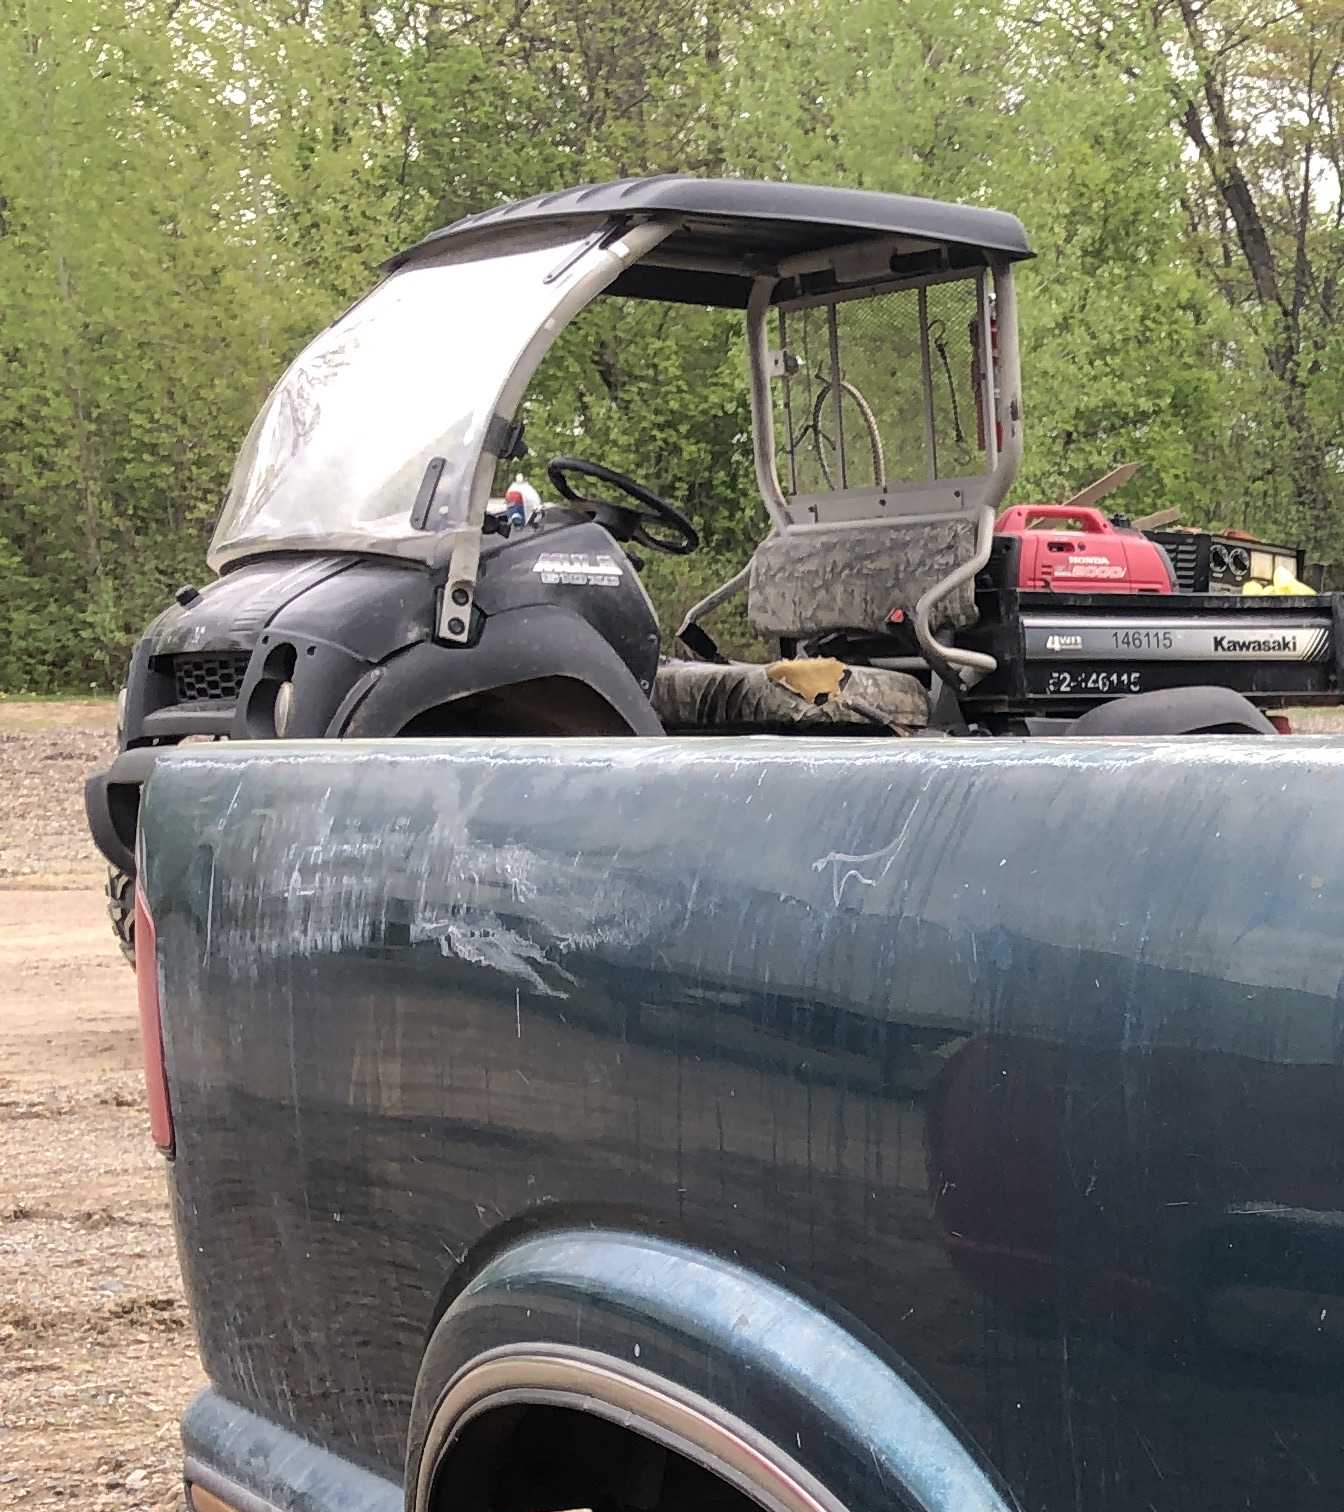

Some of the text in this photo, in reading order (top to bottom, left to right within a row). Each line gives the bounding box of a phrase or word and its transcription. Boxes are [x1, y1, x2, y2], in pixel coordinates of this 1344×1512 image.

[533, 553, 623, 575] MULE
[1068, 555, 1110, 565] HONDA
[1112, 631, 1173, 649] 146115
[1213, 635, 1297, 652] Kawasaki
